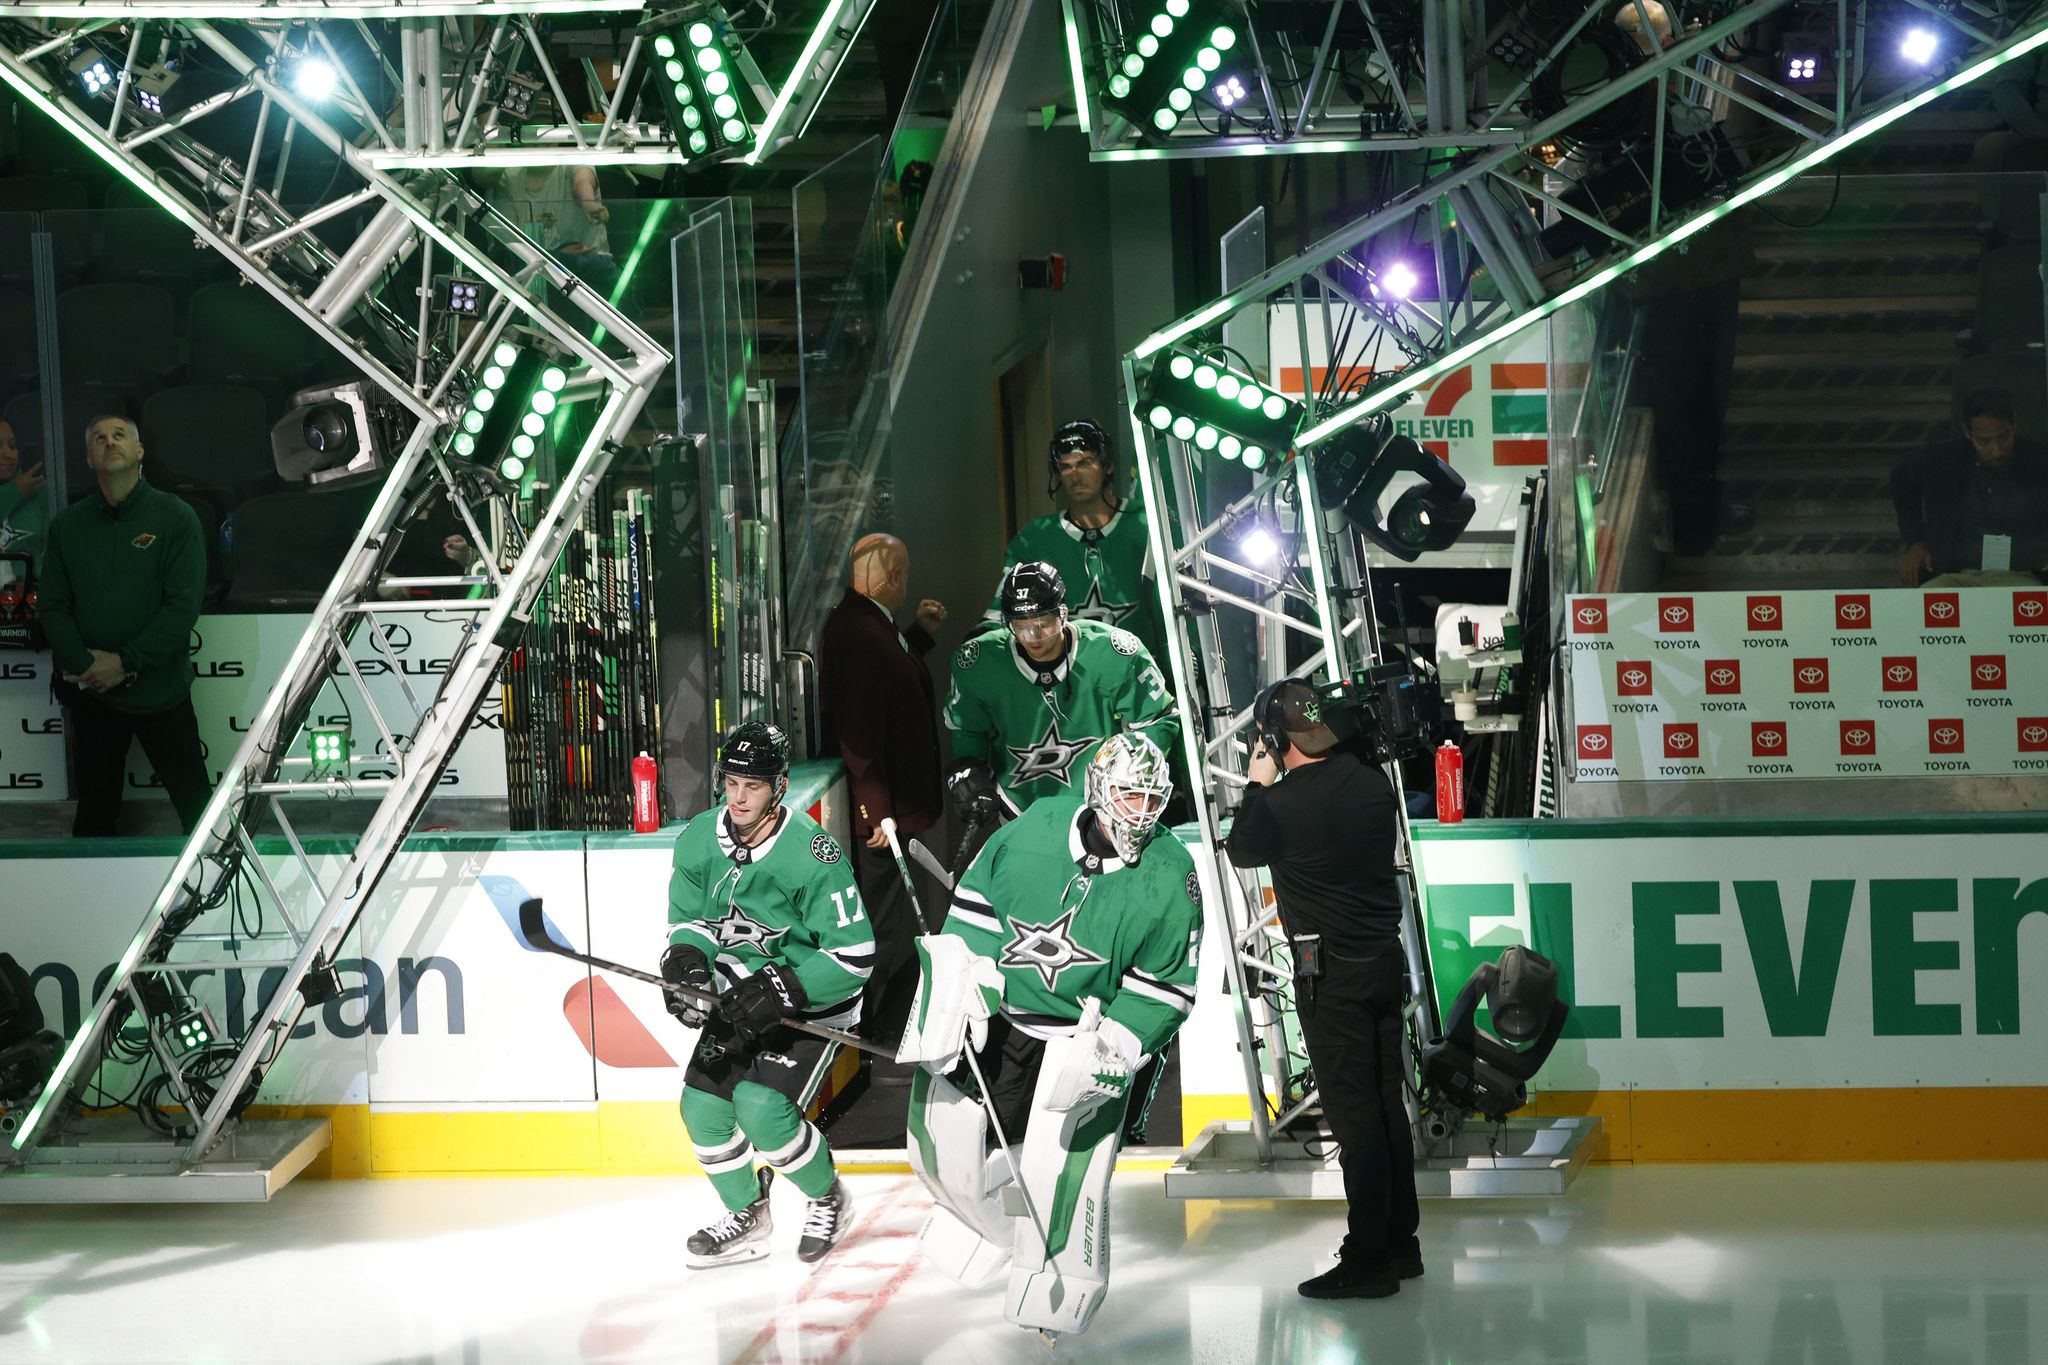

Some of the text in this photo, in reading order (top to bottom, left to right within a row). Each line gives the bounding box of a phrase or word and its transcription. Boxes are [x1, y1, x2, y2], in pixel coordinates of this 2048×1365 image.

[630, 534, 639, 593] VAPOR
[1016, 588, 1029, 599] 37
[579, 579, 587, 622] CCM
[1655, 640, 1700, 649] TOYOTA
[1743, 639, 1788, 648] TOYOTA
[1832, 638, 1877, 646] TOYOTA
[1920, 635, 1966, 645] TOYOTA
[1569, 642, 1614, 651] TOYOTA
[333, 659, 450, 676] LEXUS
[1701, 703, 1746, 711] TOYOTA
[1789, 701, 1835, 710] TOYOTA
[1878, 700, 1923, 709] TOYOTA
[1966, 698, 2012, 707] TOYOTA
[1613, 704, 1658, 713] TOYOTA
[737, 741, 751, 752] 17
[1659, 766, 1705, 775] TOYOTA
[1747, 764, 1793, 774] TOYOTA
[1836, 763, 1881, 773] TOYOTA
[1924, 761, 1970, 771] TOYOTA
[830, 885, 866, 929] 17
[763, 963, 794, 1008] CCM
